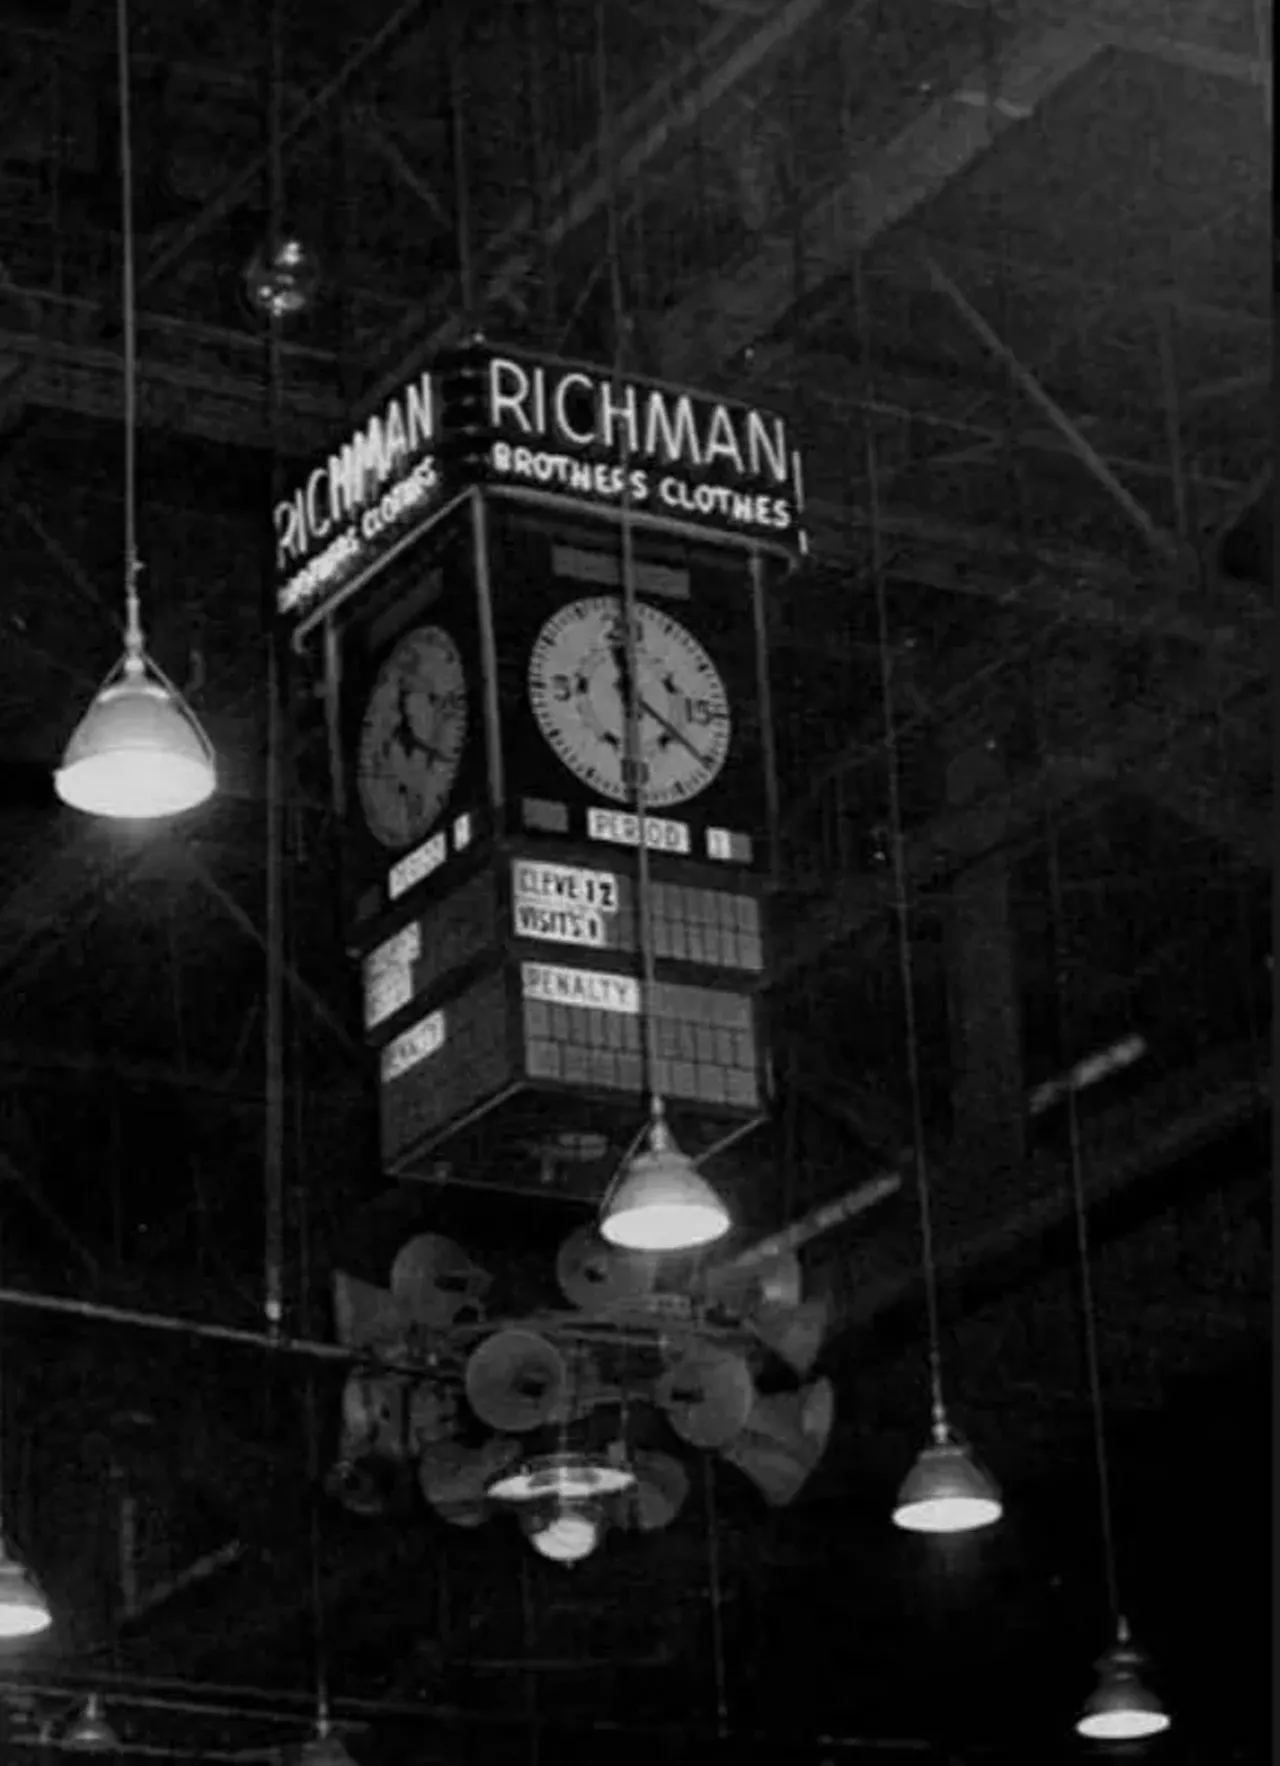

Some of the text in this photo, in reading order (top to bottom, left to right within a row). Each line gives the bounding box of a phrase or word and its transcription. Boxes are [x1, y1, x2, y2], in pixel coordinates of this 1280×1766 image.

[490, 358, 786, 481] RICHMAN
[659, 476, 793, 529] CLOTHES
[526, 967, 629, 1004] PENALTY
